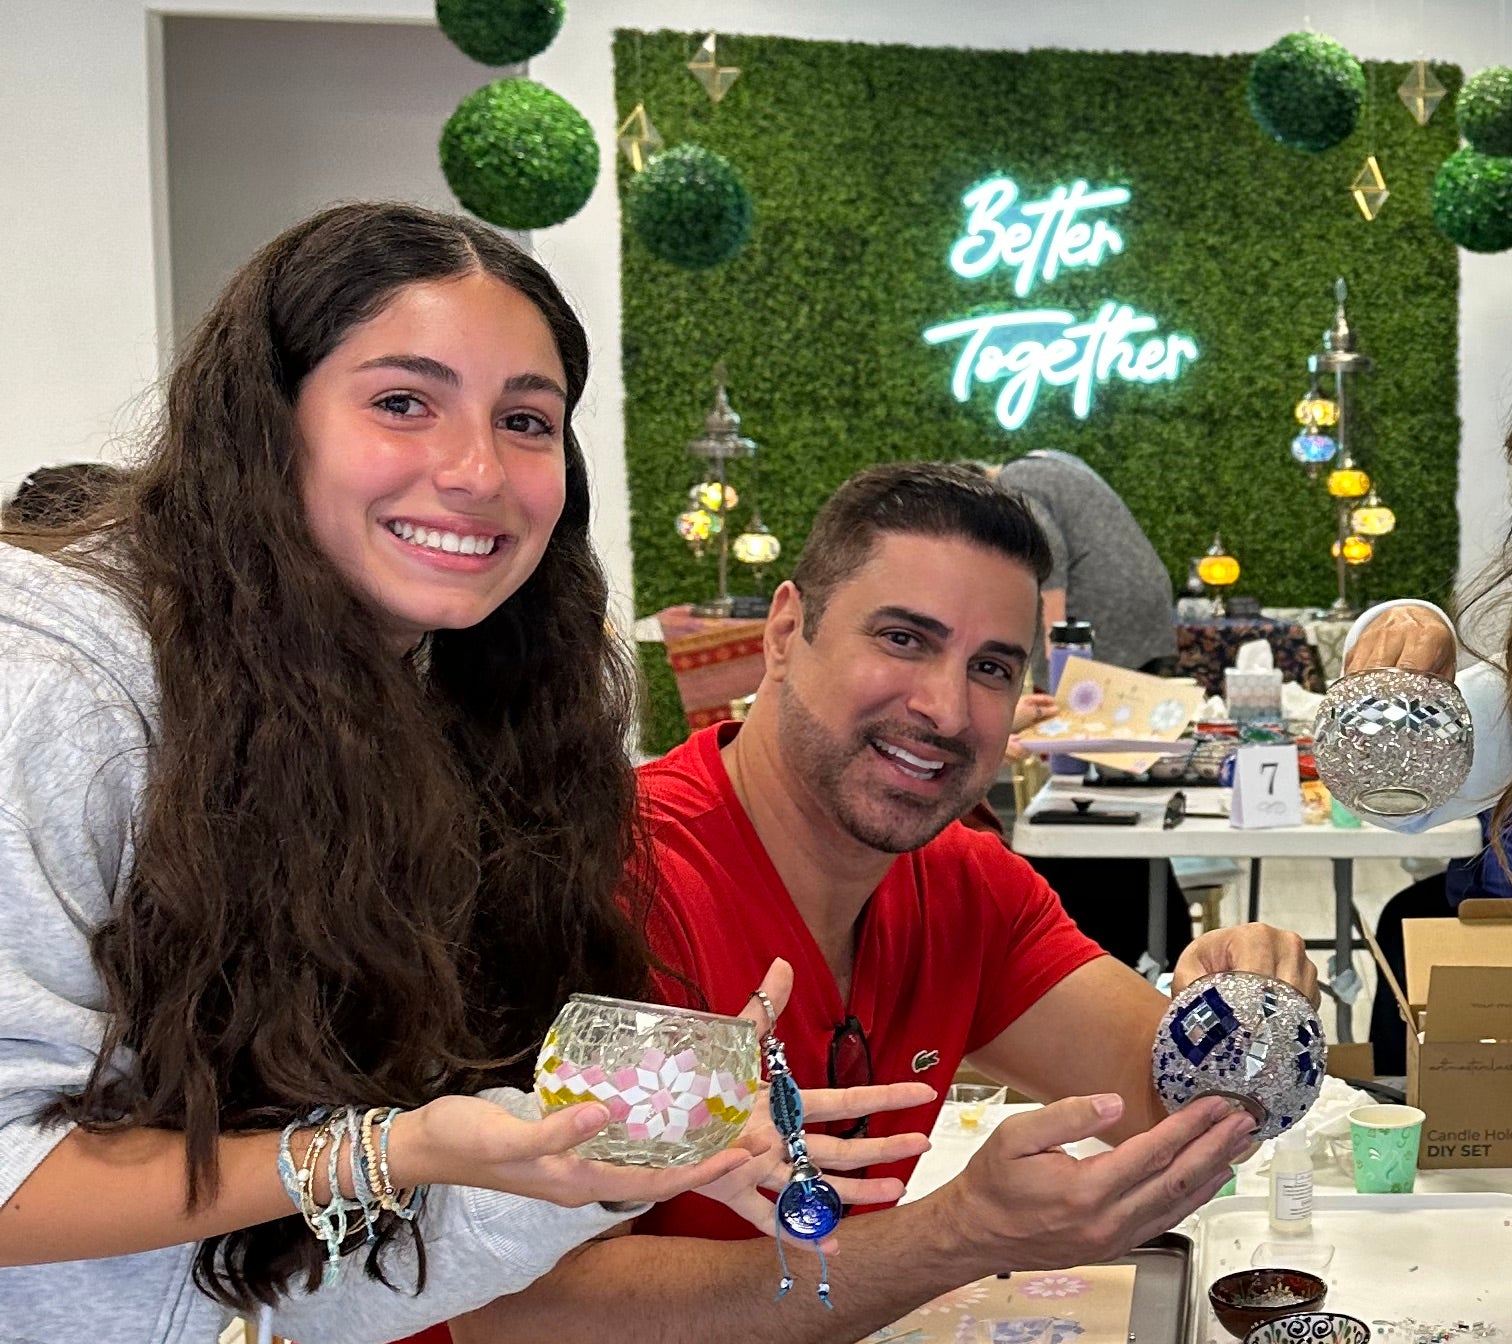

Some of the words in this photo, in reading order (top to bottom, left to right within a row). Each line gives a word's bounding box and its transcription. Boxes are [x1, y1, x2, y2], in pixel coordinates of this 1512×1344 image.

[949, 176, 1132, 297] Better
[922, 301, 1200, 430] Together
[1260, 762, 1279, 795] 7
[1427, 1129, 1481, 1143] Candle
[1427, 1144, 1456, 1158] DIY
[1461, 1144, 1493, 1157] SET
